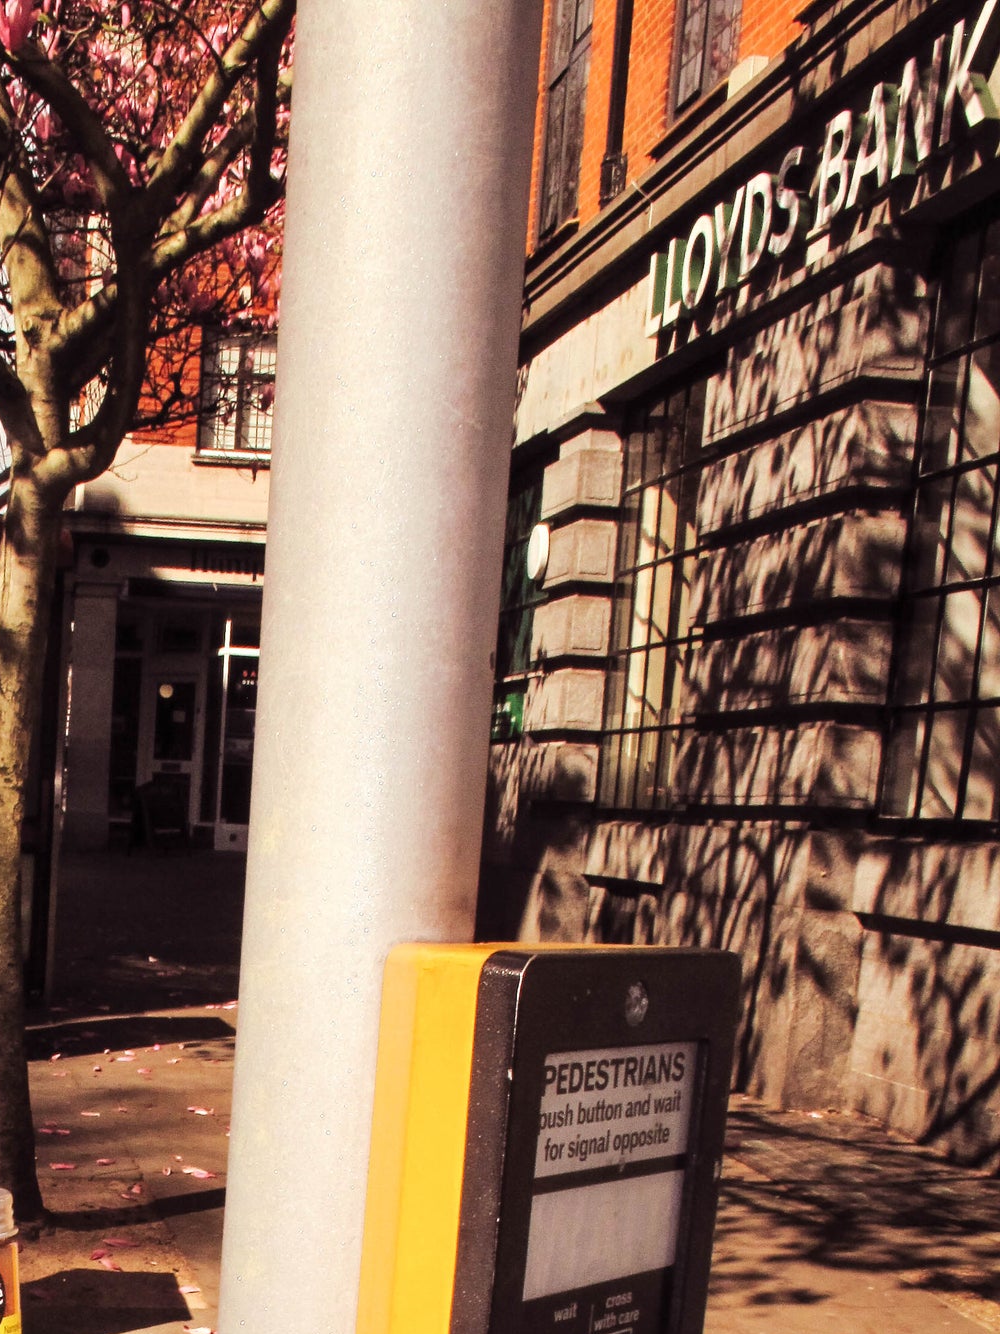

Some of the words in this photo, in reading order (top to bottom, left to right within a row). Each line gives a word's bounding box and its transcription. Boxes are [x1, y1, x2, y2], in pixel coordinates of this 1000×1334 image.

[644, 147, 808, 338] LLOYDS
[810, 0, 1000, 232] BANK
[542, 1051, 686, 1097] PEDESTRIANS
[538, 1105, 574, 1137] push
[577, 1098, 623, 1126] button
[625, 1097, 650, 1120] and
[653, 1092, 682, 1114] wait
[544, 1138, 565, 1161] for
[568, 1129, 611, 1162] signal
[613, 1127, 670, 1160] opposite
[554, 1303, 578, 1322] wait
[605, 1292, 633, 1310] cross
[594, 1311, 616, 1331] with
[617, 1308, 640, 1326] care
